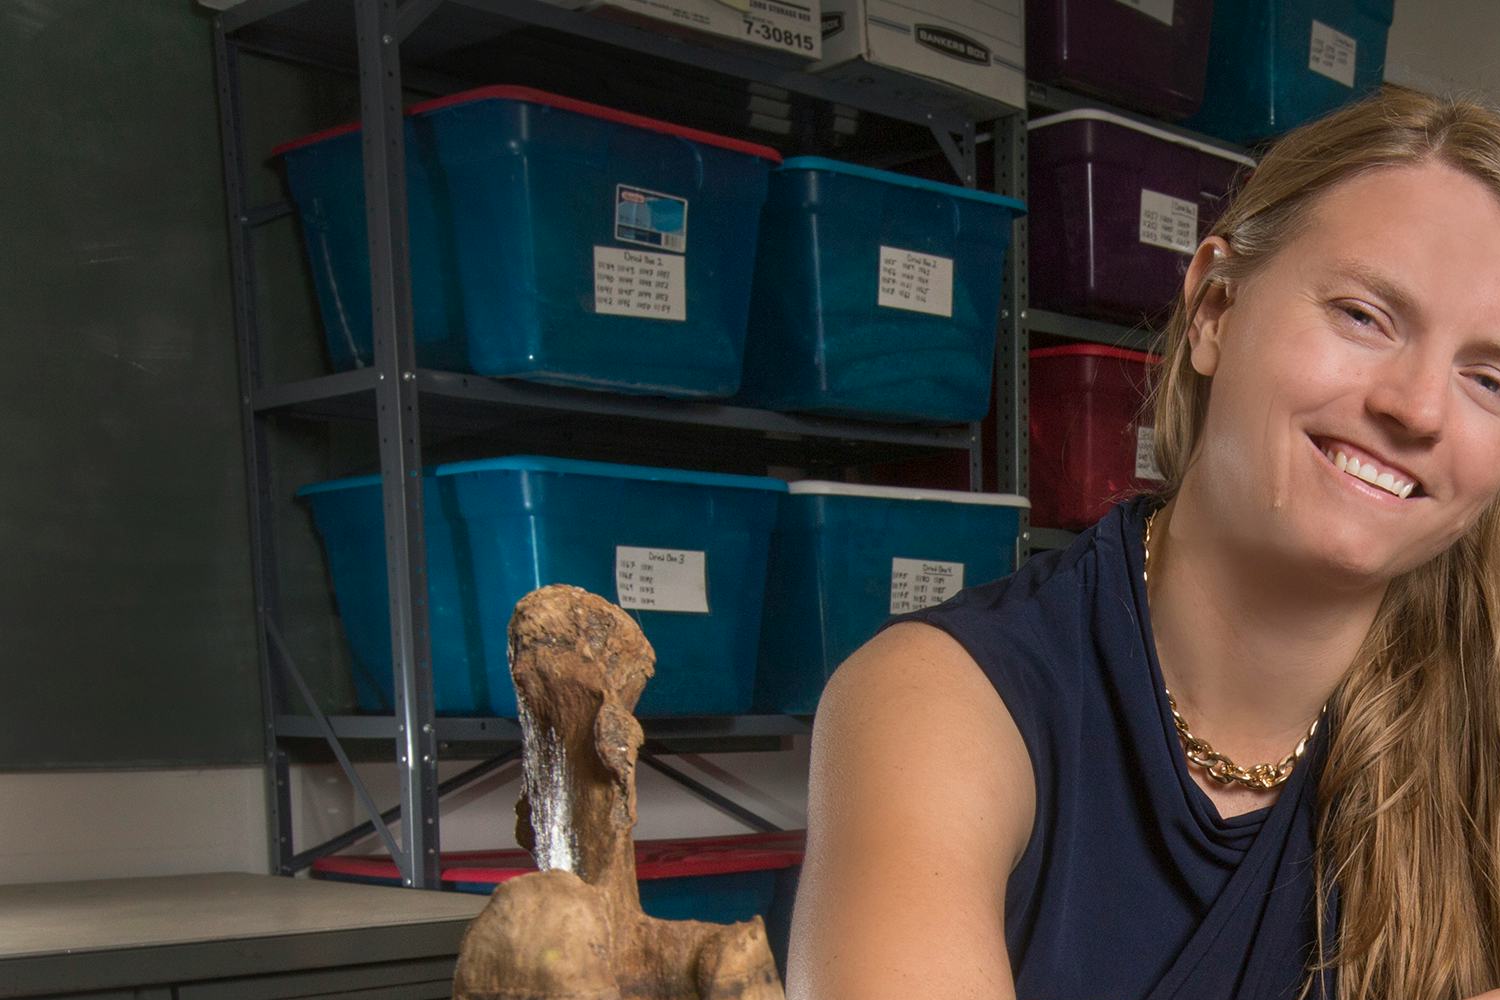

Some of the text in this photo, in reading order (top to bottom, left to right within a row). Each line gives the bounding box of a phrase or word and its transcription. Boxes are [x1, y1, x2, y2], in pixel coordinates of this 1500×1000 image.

[743, 19, 814, 51] 7-30815
[919, 30, 987, 61] BANKERS BOX
[679, 554, 686, 564] 3
